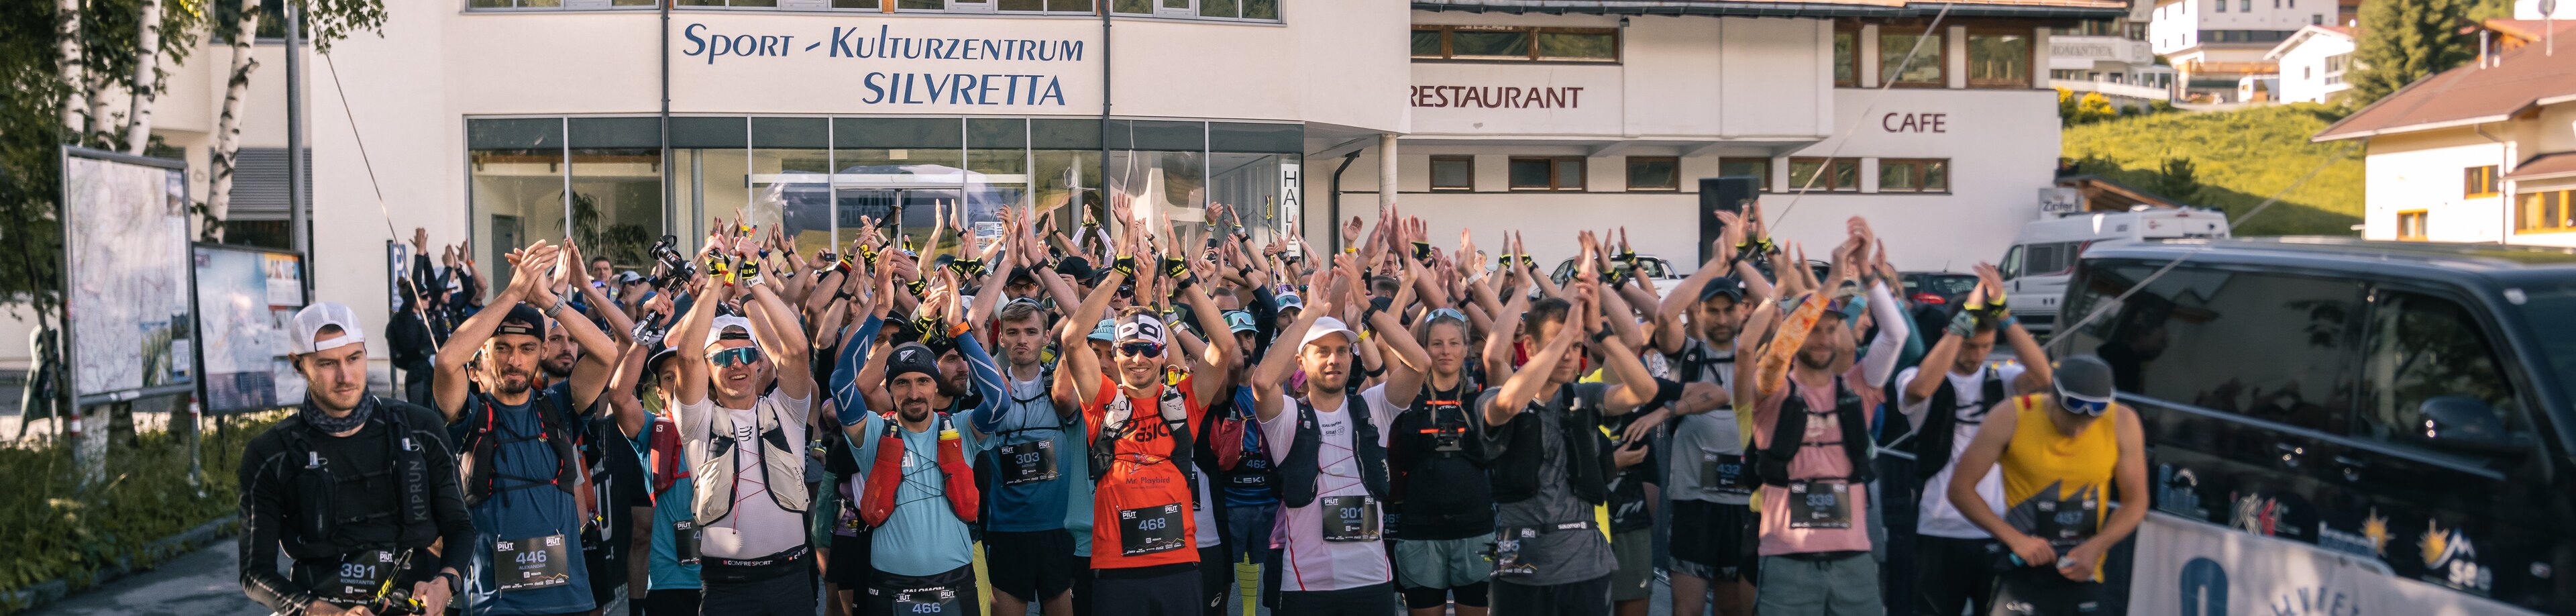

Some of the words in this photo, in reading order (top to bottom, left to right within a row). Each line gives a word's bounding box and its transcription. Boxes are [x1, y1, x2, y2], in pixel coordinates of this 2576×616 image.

[2051, 43, 2113, 56] ROMANTICA
[863, 72, 1065, 105] SILVRETTA
[1409, 85, 1584, 109] RESTAURANT
[1882, 113, 1946, 133] CAFE
[1169, 264, 1185, 274] LEKI
[912, 282, 925, 294] LEKI
[1135, 421, 1168, 442] asic
[1016, 452, 1040, 464] 303
[1246, 460, 1266, 468] 462
[1717, 464, 1740, 474] 432
[1140, 477, 1170, 486] Playbird
[409, 461, 427, 521] KIPRUN
[1340, 507, 1363, 519] 301
[1138, 517, 1166, 531] 468
[516, 550, 547, 564] 446
[341, 564, 376, 579] 391
[2449, 560, 2491, 591] see
[912, 603, 941, 613] 466
